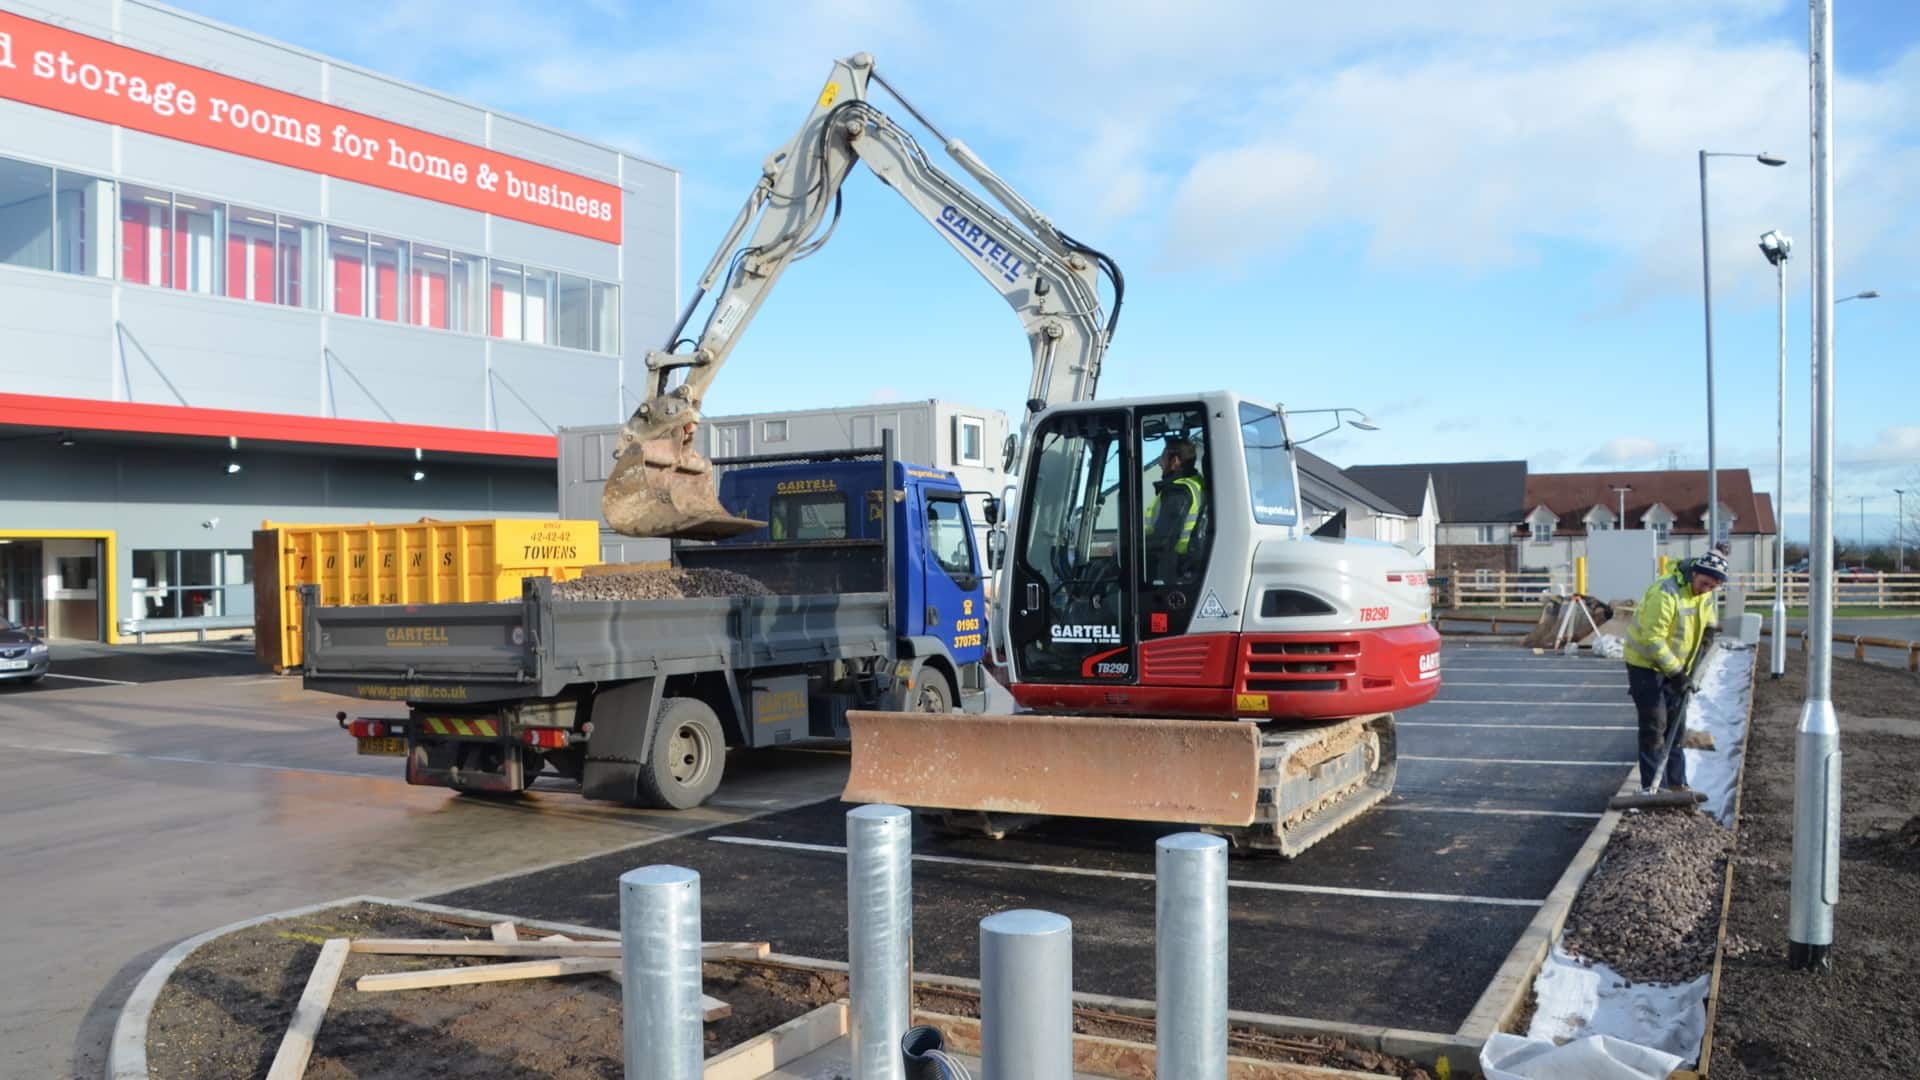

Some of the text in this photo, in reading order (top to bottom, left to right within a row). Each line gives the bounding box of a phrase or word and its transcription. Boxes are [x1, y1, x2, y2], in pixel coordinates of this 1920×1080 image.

[33, 50, 197, 116] storage
[208, 96, 321, 147] rooms
[331, 124, 379, 161] for
[387, 138, 468, 184] home
[476, 163, 498, 192] &
[506, 170, 612, 222] business
[942, 205, 1022, 277] GARTELL
[777, 480, 837, 490] GARTELL
[530, 531, 571, 541] 42-42-42
[523, 545, 577, 560] TOWENS
[1360, 606, 1389, 622] TB290
[385, 626, 448, 641] GARTELL
[1051, 624, 1121, 638] GARTELL
[1098, 663, 1129, 674] TB290
[357, 684, 467, 699] www.gartell.co.uk
